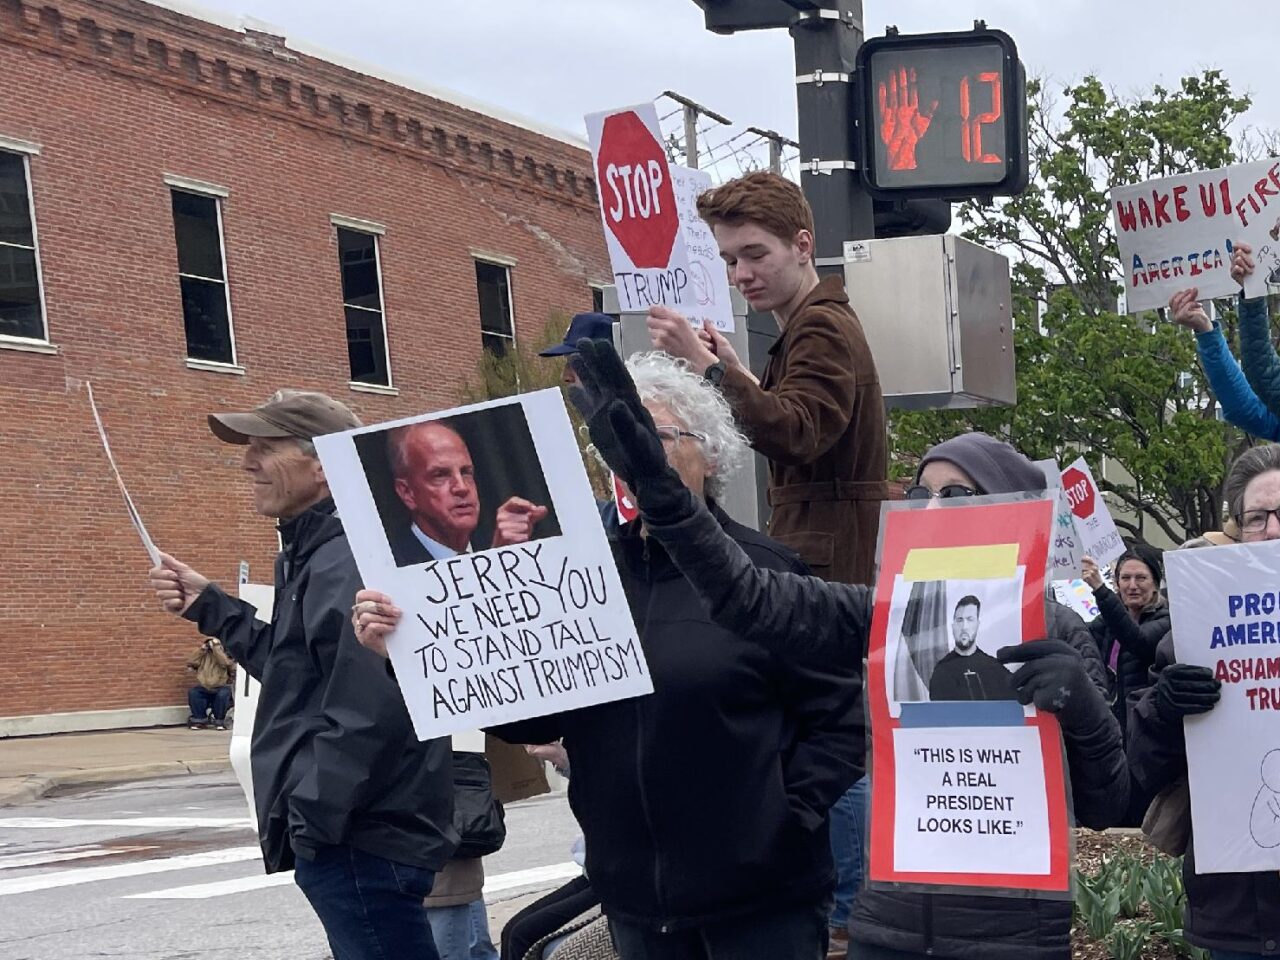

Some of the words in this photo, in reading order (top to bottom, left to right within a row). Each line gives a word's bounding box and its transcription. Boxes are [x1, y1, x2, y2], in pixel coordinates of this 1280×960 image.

[960, 71, 1001, 164] 12
[606, 160, 663, 222] STOP
[1117, 186, 1191, 232] WAKE
[615, 268, 688, 308] TRUMP
[1066, 479, 1090, 509] STOP
[425, 543, 546, 604] JERRY
[417, 605, 469, 640] WE
[472, 589, 541, 628] NEED
[529, 556, 608, 614] YOU
[415, 642, 448, 679] TO
[455, 628, 542, 670] STAND
[542, 617, 612, 649] TALL
[432, 664, 526, 719] AGAINST
[524, 638, 644, 698] TRUMPISM
[958, 748, 974, 763] IS
[977, 749, 1021, 765] WHAT
[942, 772, 953, 787] A
[957, 772, 997, 788] REAL
[917, 817, 973, 834] LOOKS
[926, 795, 1014, 812] PRESIDENT
